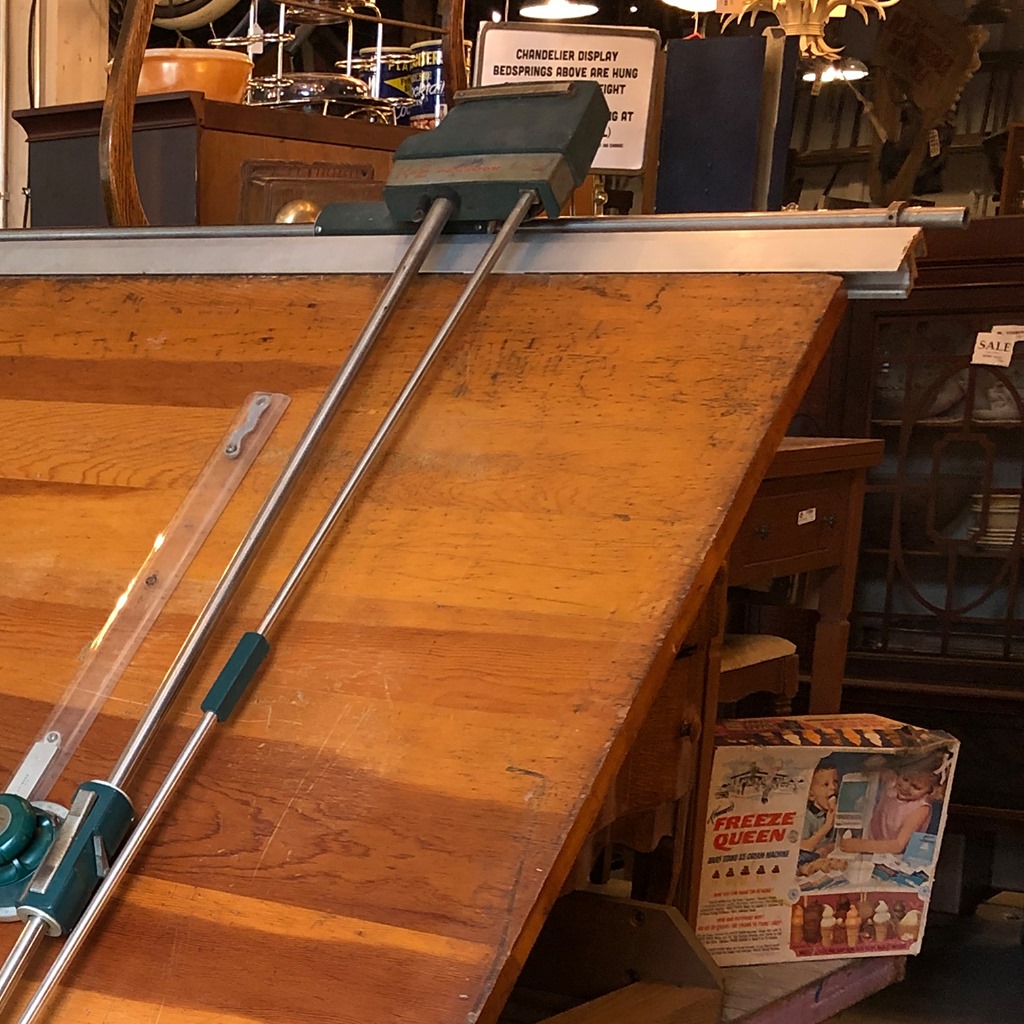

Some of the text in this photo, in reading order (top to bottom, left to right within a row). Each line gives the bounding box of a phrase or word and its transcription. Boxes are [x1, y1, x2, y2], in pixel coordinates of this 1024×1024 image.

[516, 49, 619, 62] CHANDELIER DISPLAY
[493, 65, 639, 79] BEDSPRINGS ABOVE ARE HUNG
[621, 111, 634, 122] AT
[978, 340, 1012, 352] SALE
[713, 811, 797, 832] FREEZE
[713, 828, 787, 852] QUEEN
